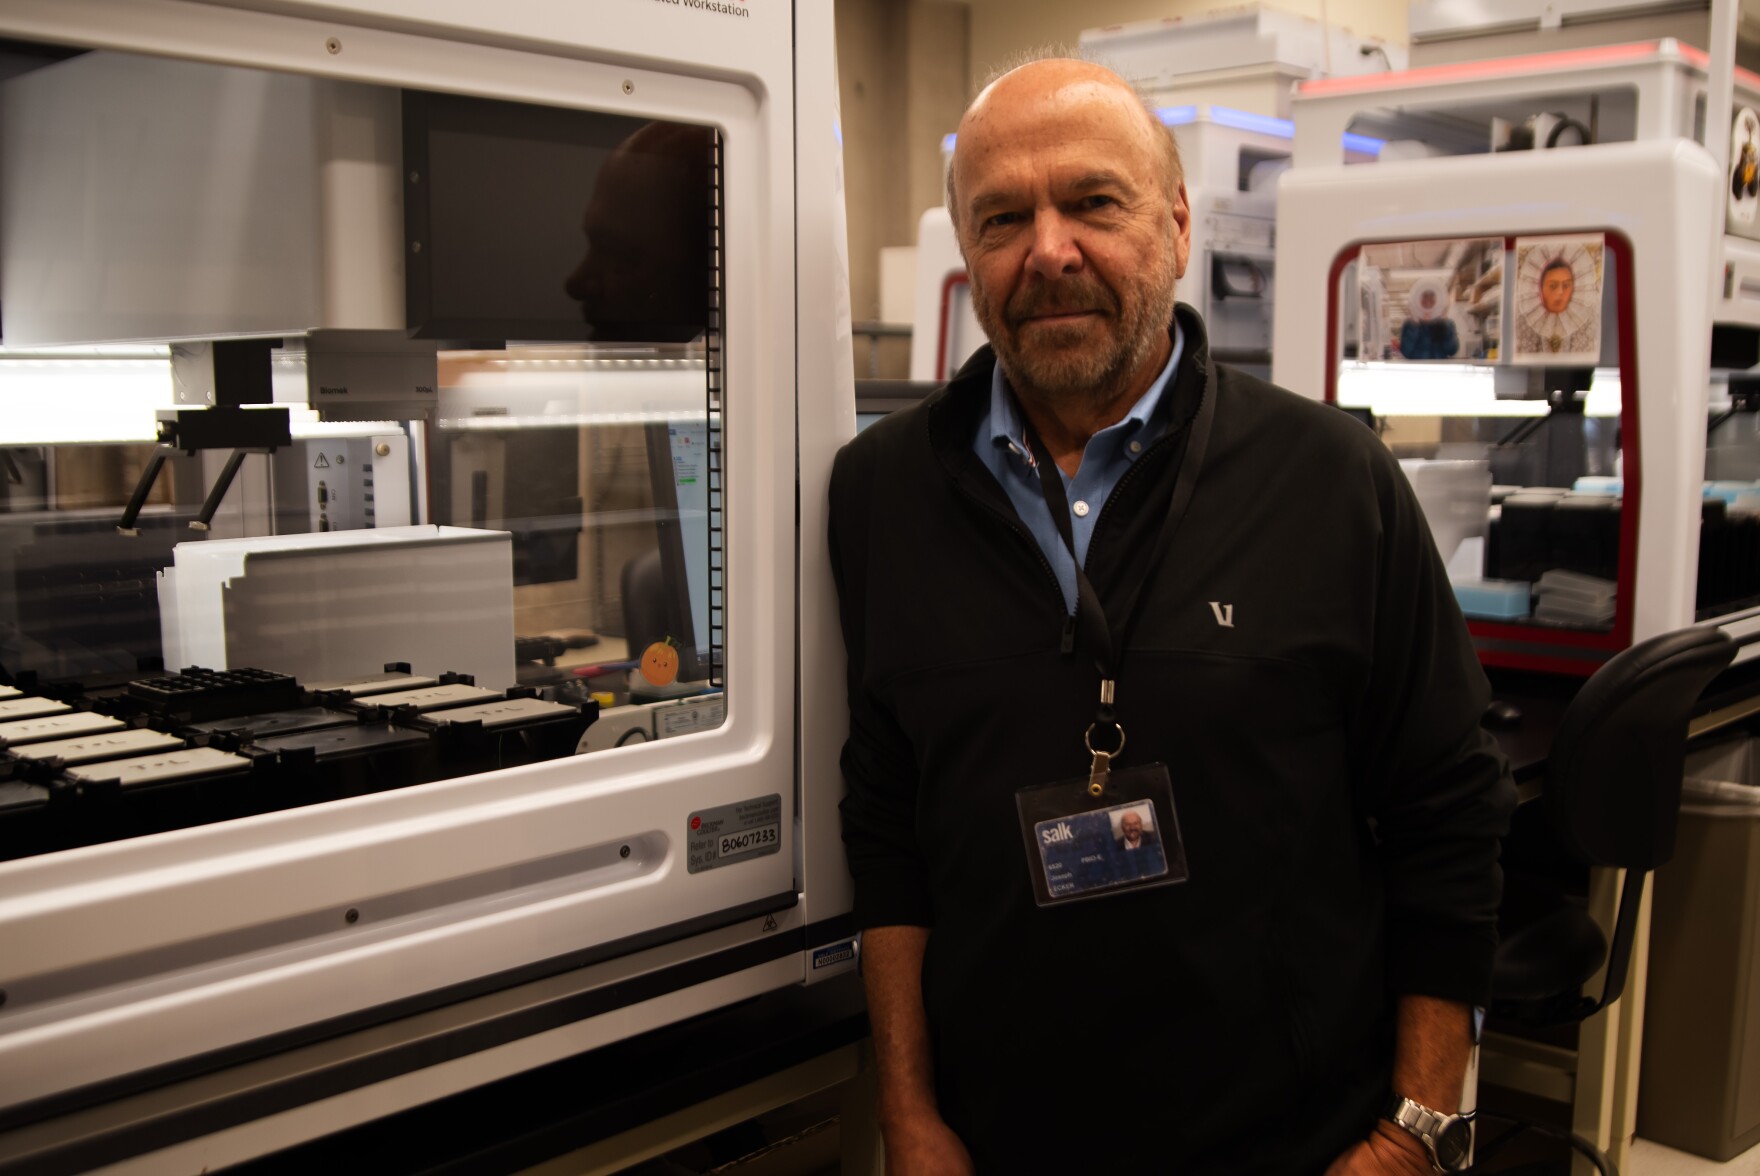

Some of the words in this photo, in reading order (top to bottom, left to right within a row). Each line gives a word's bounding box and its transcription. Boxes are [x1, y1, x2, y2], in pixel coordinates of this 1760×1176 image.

[683, 0, 749, 18] Workstation
[722, 828, 776, 853] 80607233
[1042, 822, 1074, 844] salk
